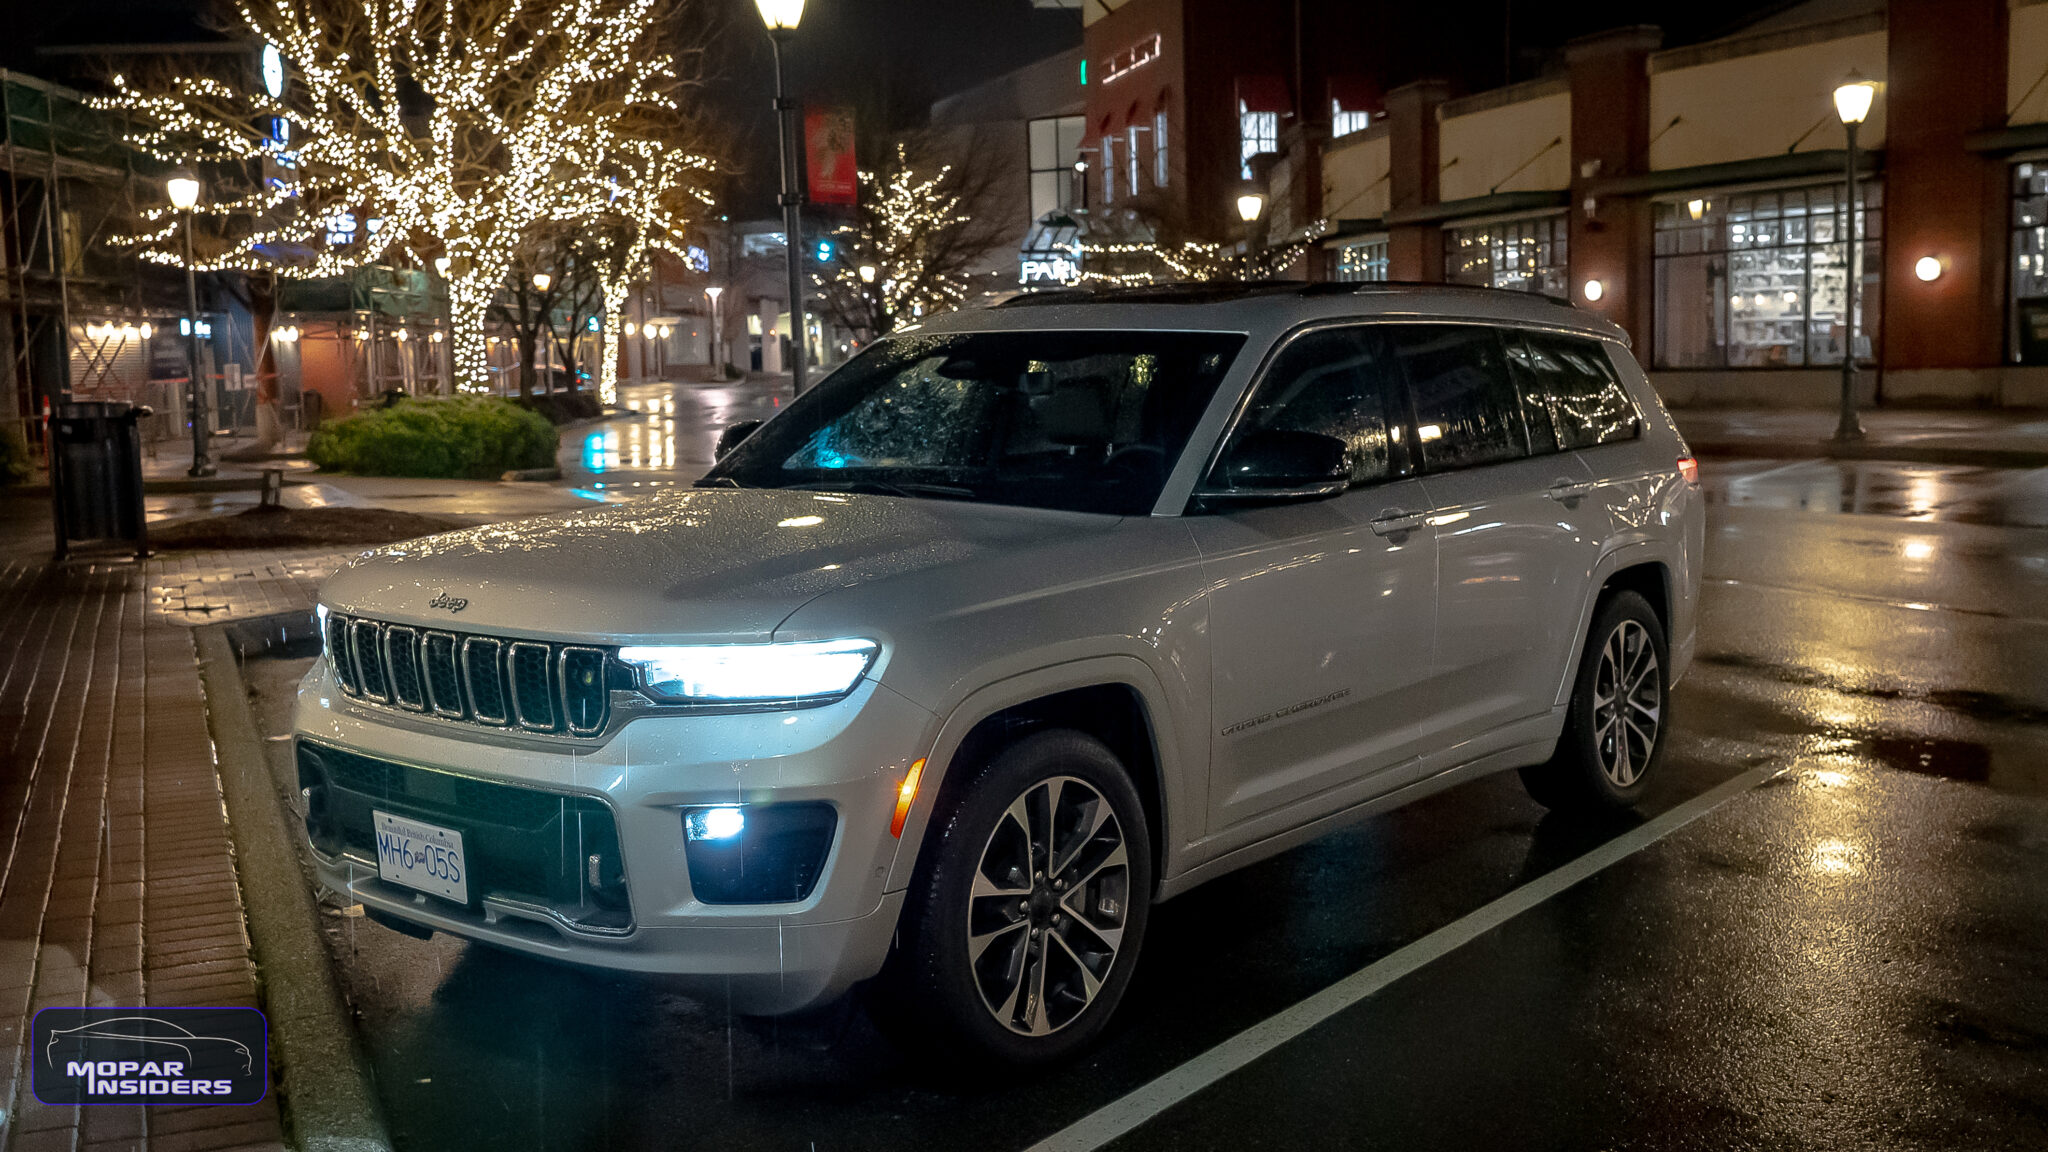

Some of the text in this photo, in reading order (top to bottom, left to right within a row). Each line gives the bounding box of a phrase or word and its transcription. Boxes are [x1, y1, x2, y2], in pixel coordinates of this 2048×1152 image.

[429, 588, 468, 614] Jeep
[378, 832, 414, 870] MH6
[425, 834, 454, 849] Columbia
